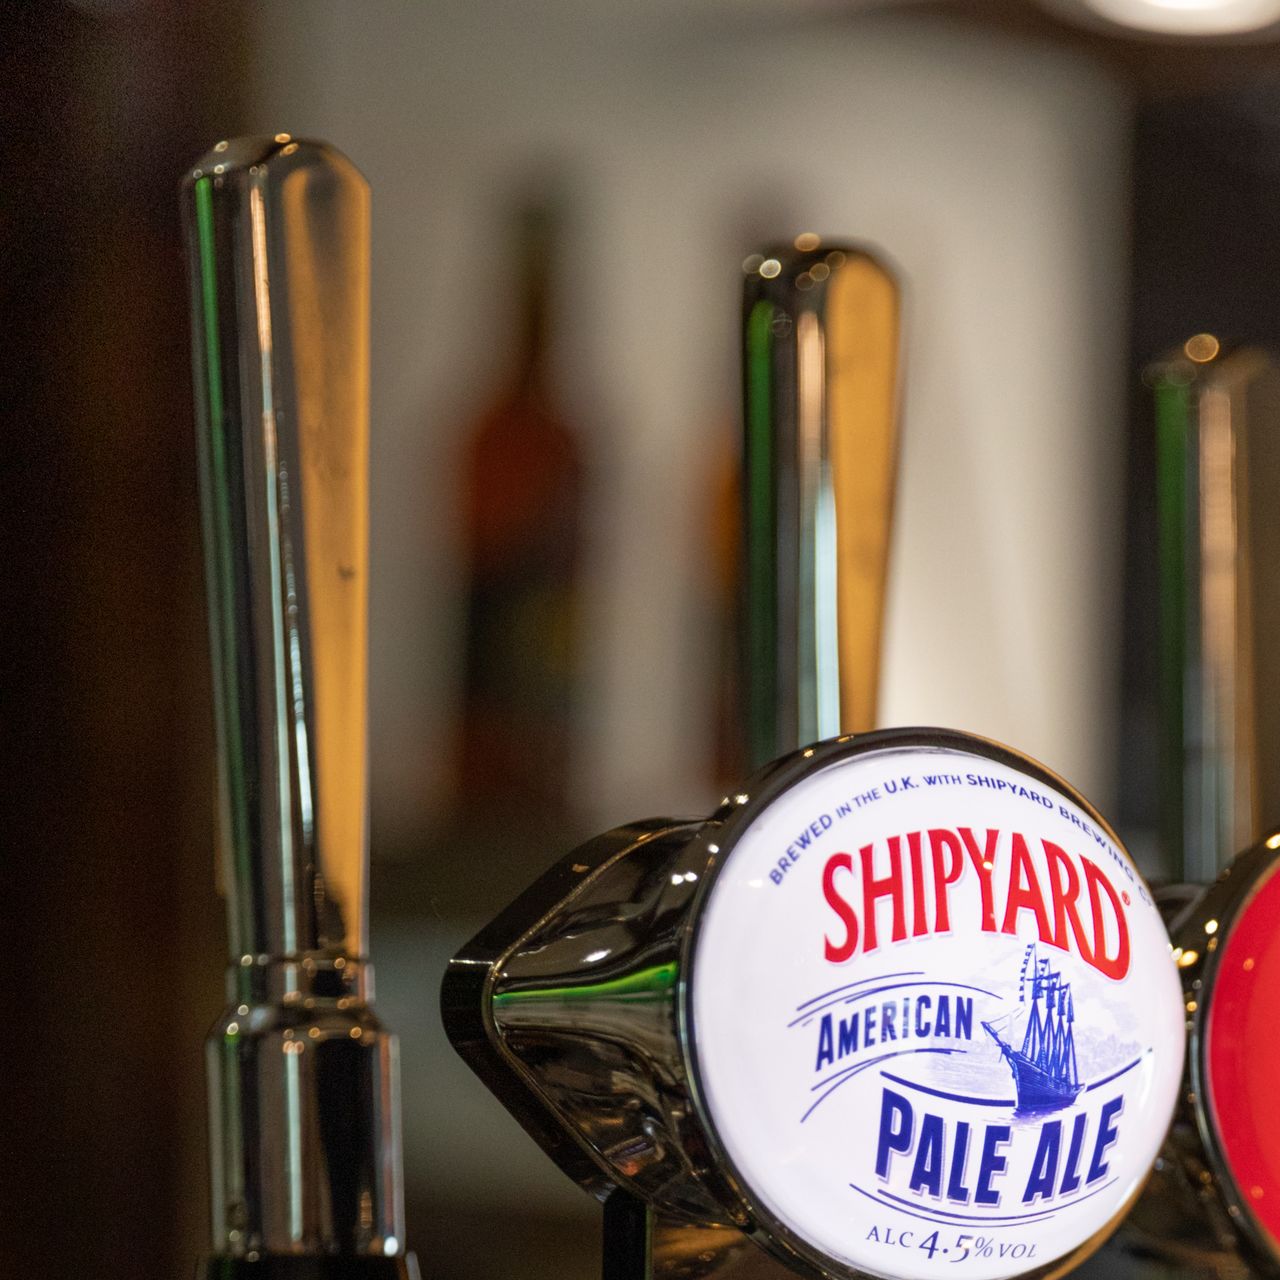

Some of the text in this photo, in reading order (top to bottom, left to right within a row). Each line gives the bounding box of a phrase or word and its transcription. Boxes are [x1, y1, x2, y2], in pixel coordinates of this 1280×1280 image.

[768, 813, 833, 886] BREWED
[835, 802, 852, 819] IN
[852, 787, 882, 808] THE
[884, 776, 919, 794] U.K.
[923, 774, 962, 787] WITH
[966, 774, 1054, 810] SHIPYARD
[1058, 805, 1135, 883] BREWING
[814, 994, 974, 1072] AMERICAN
[874, 1086, 1125, 1206] PALE ALE
[866, 1225, 914, 1248] ALC
[999, 1243, 1038, 1259] VOL
